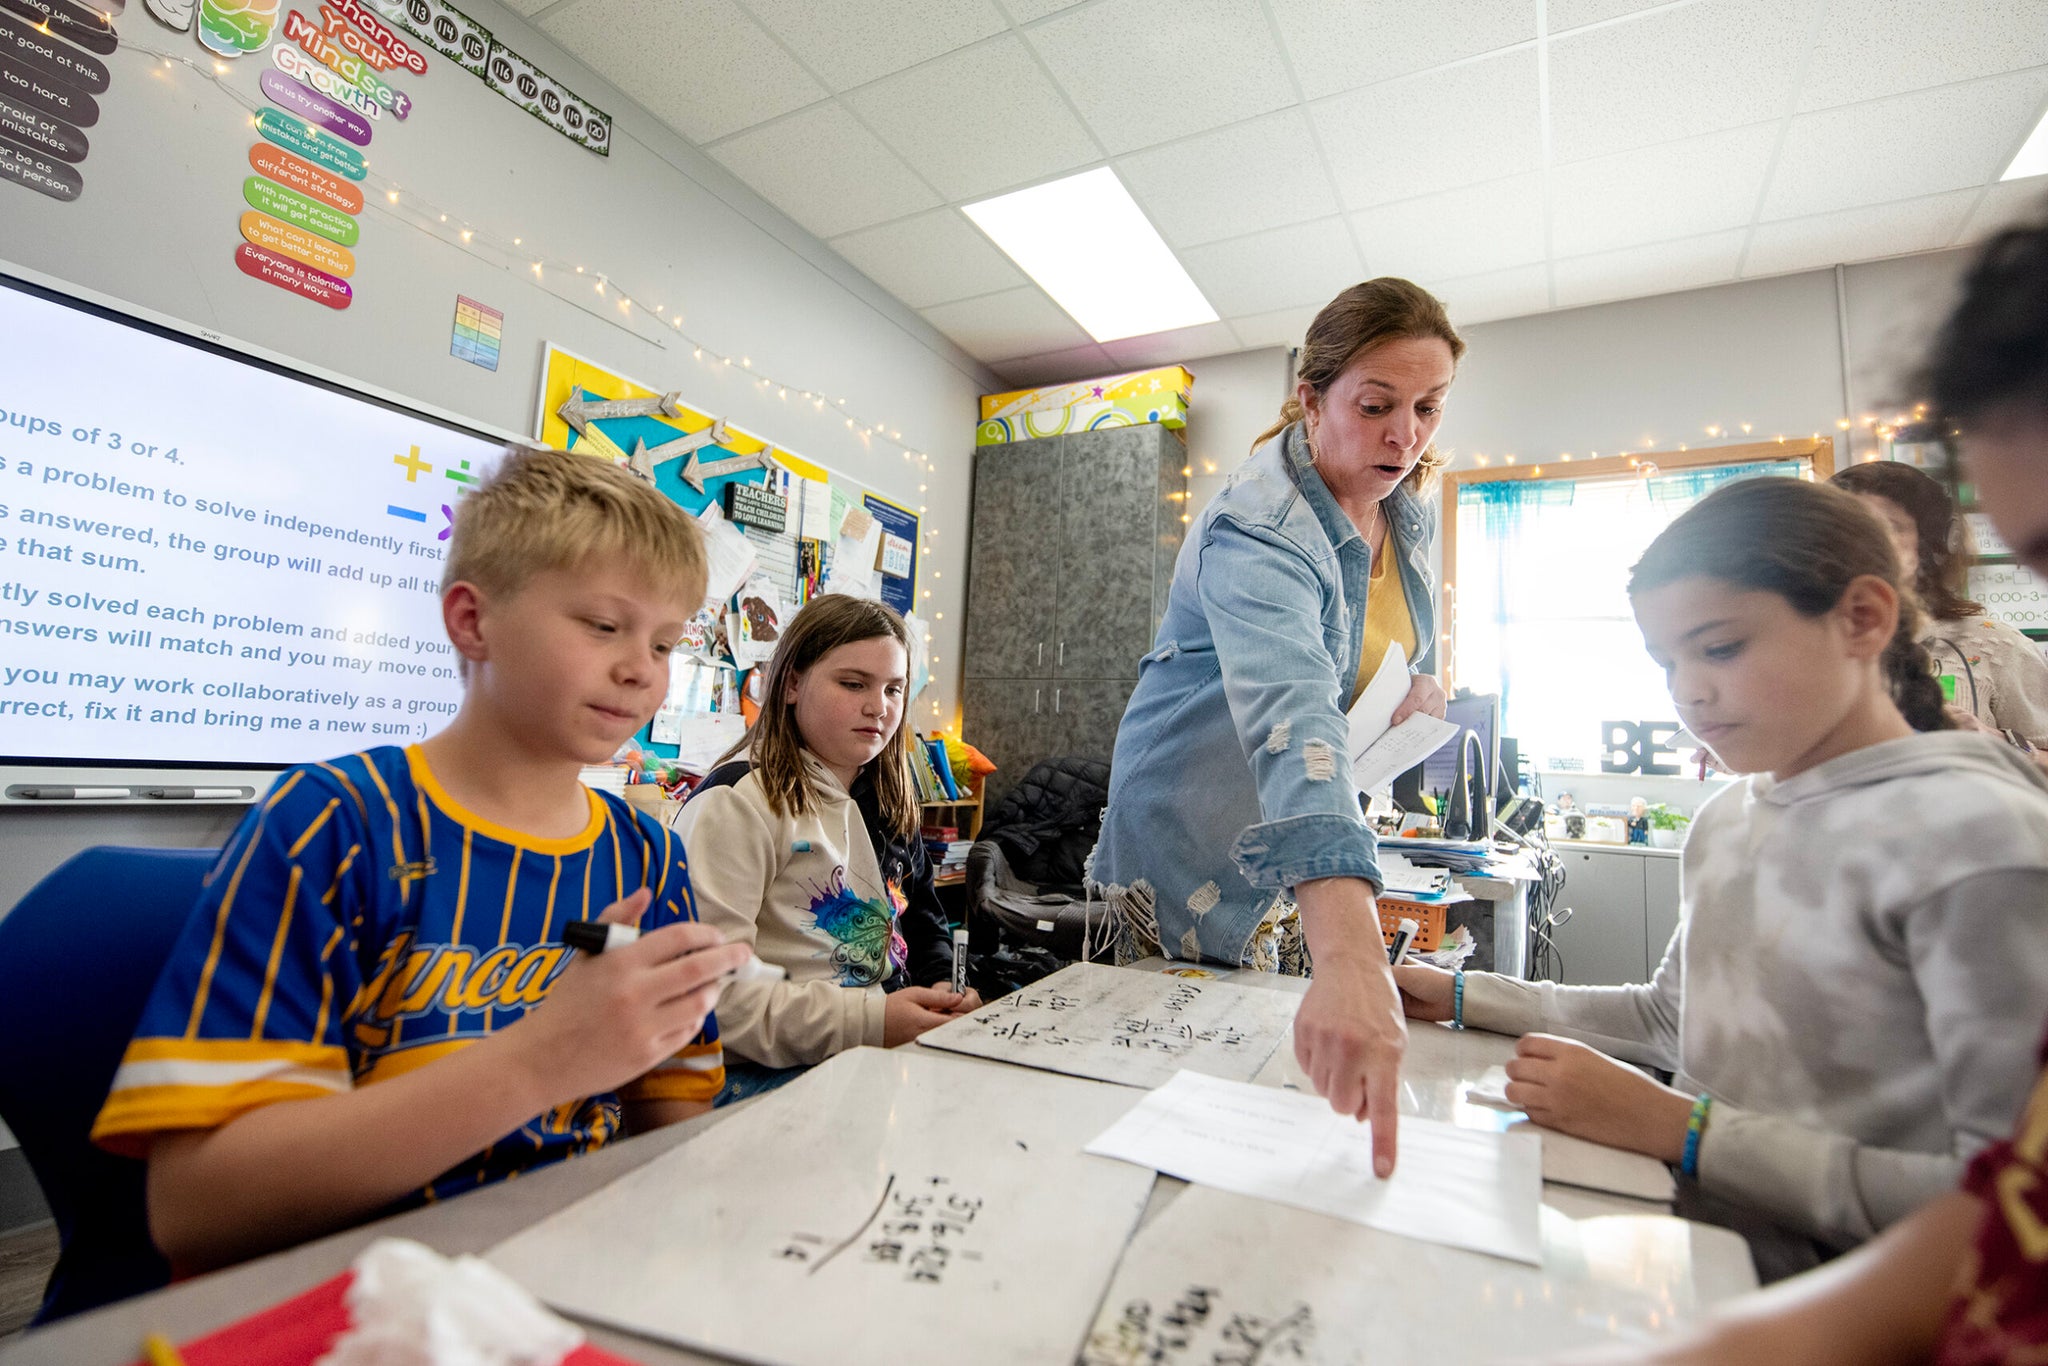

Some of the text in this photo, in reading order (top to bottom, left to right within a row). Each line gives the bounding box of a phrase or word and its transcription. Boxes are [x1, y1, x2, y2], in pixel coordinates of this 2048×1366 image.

[54, 9, 74, 25] up.
[326, 10, 393, 67] Your
[17, 37, 53, 59] good
[57, 56, 72, 68] at
[75, 63, 100, 82] this.
[289, 16, 407, 115] Mindset
[411, 2, 603, 139] 113 114 115 116 117 118 119 120
[3, 70, 71, 108] too hard.
[277, 47, 377, 116] Growth
[40, 121, 57, 134] of
[269, 78, 366, 137] Let us try another way.
[2, 118, 68, 152] mistakes.
[262, 123, 360, 175] mistakes and get better.
[286, 122, 302, 135] can
[304, 130, 326, 146] learn
[327, 144, 348, 158] from
[16, 151, 32, 165] be
[36, 161, 52, 174] as
[23, 169, 71, 194] person.
[280, 157, 337, 190] I can try a
[257, 159, 357, 210] different strategy.
[254, 181, 353, 230] With more practice
[262, 196, 345, 237] it will get easier!
[248, 226, 349, 272] to get better at this?
[259, 219, 339, 258] What can I learn
[245, 247, 347, 294] Everyone is talented
[274, 270, 301, 287] many
[303, 282, 330, 298] ways.
[72, 427, 101, 444] of
[107, 431, 122, 449] 3
[131, 441, 158, 459] or
[164, 447, 185, 466] 4.
[17, 461, 33, 476] a
[43, 466, 155, 501] problem
[163, 488, 187, 508] to
[194, 497, 257, 522] solve
[263, 509, 404, 555] independently
[409, 541, 446, 561] first.
[735, 502, 785, 522] TEACH CHILDREN
[736, 484, 786, 508] TEACHERS
[748, 498, 760, 507] LOVE
[761, 503, 785, 514] TEACHING
[735, 511, 784, 531] TO LOVE LEARNING
[17, 537, 73, 562] that
[81, 552, 146, 574] sum.
[20, 508, 159, 546] answered,
[168, 532, 206, 554] the
[213, 540, 280, 569] group
[287, 556, 322, 574] will
[327, 562, 364, 582] add
[370, 570, 392, 588] up
[398, 576, 418, 591] all
[47, 592, 139, 617] solved
[147, 605, 205, 625] each
[213, 612, 304, 637] problem
[311, 625, 347, 642] and
[353, 630, 410, 650] added
[414, 640, 453, 654] your
[108, 629, 151, 648] will
[160, 632, 233, 656] match
[240, 643, 281, 661] and
[288, 650, 326, 667] you
[333, 655, 372, 673] may
[378, 660, 426, 676] move
[432, 667, 457, 679] on.
[4, 667, 458, 716] you may work collaboratively as a group
[84, 701, 117, 721] fix
[126, 703, 142, 722] it
[150, 706, 196, 724] and
[203, 708, 263, 732] bring
[270, 715, 302, 730] me
[309, 717, 320, 731] a
[326, 718, 367, 733] new
[371, 721, 410, 735] sum
[1601, 720, 1681, 775] BE
